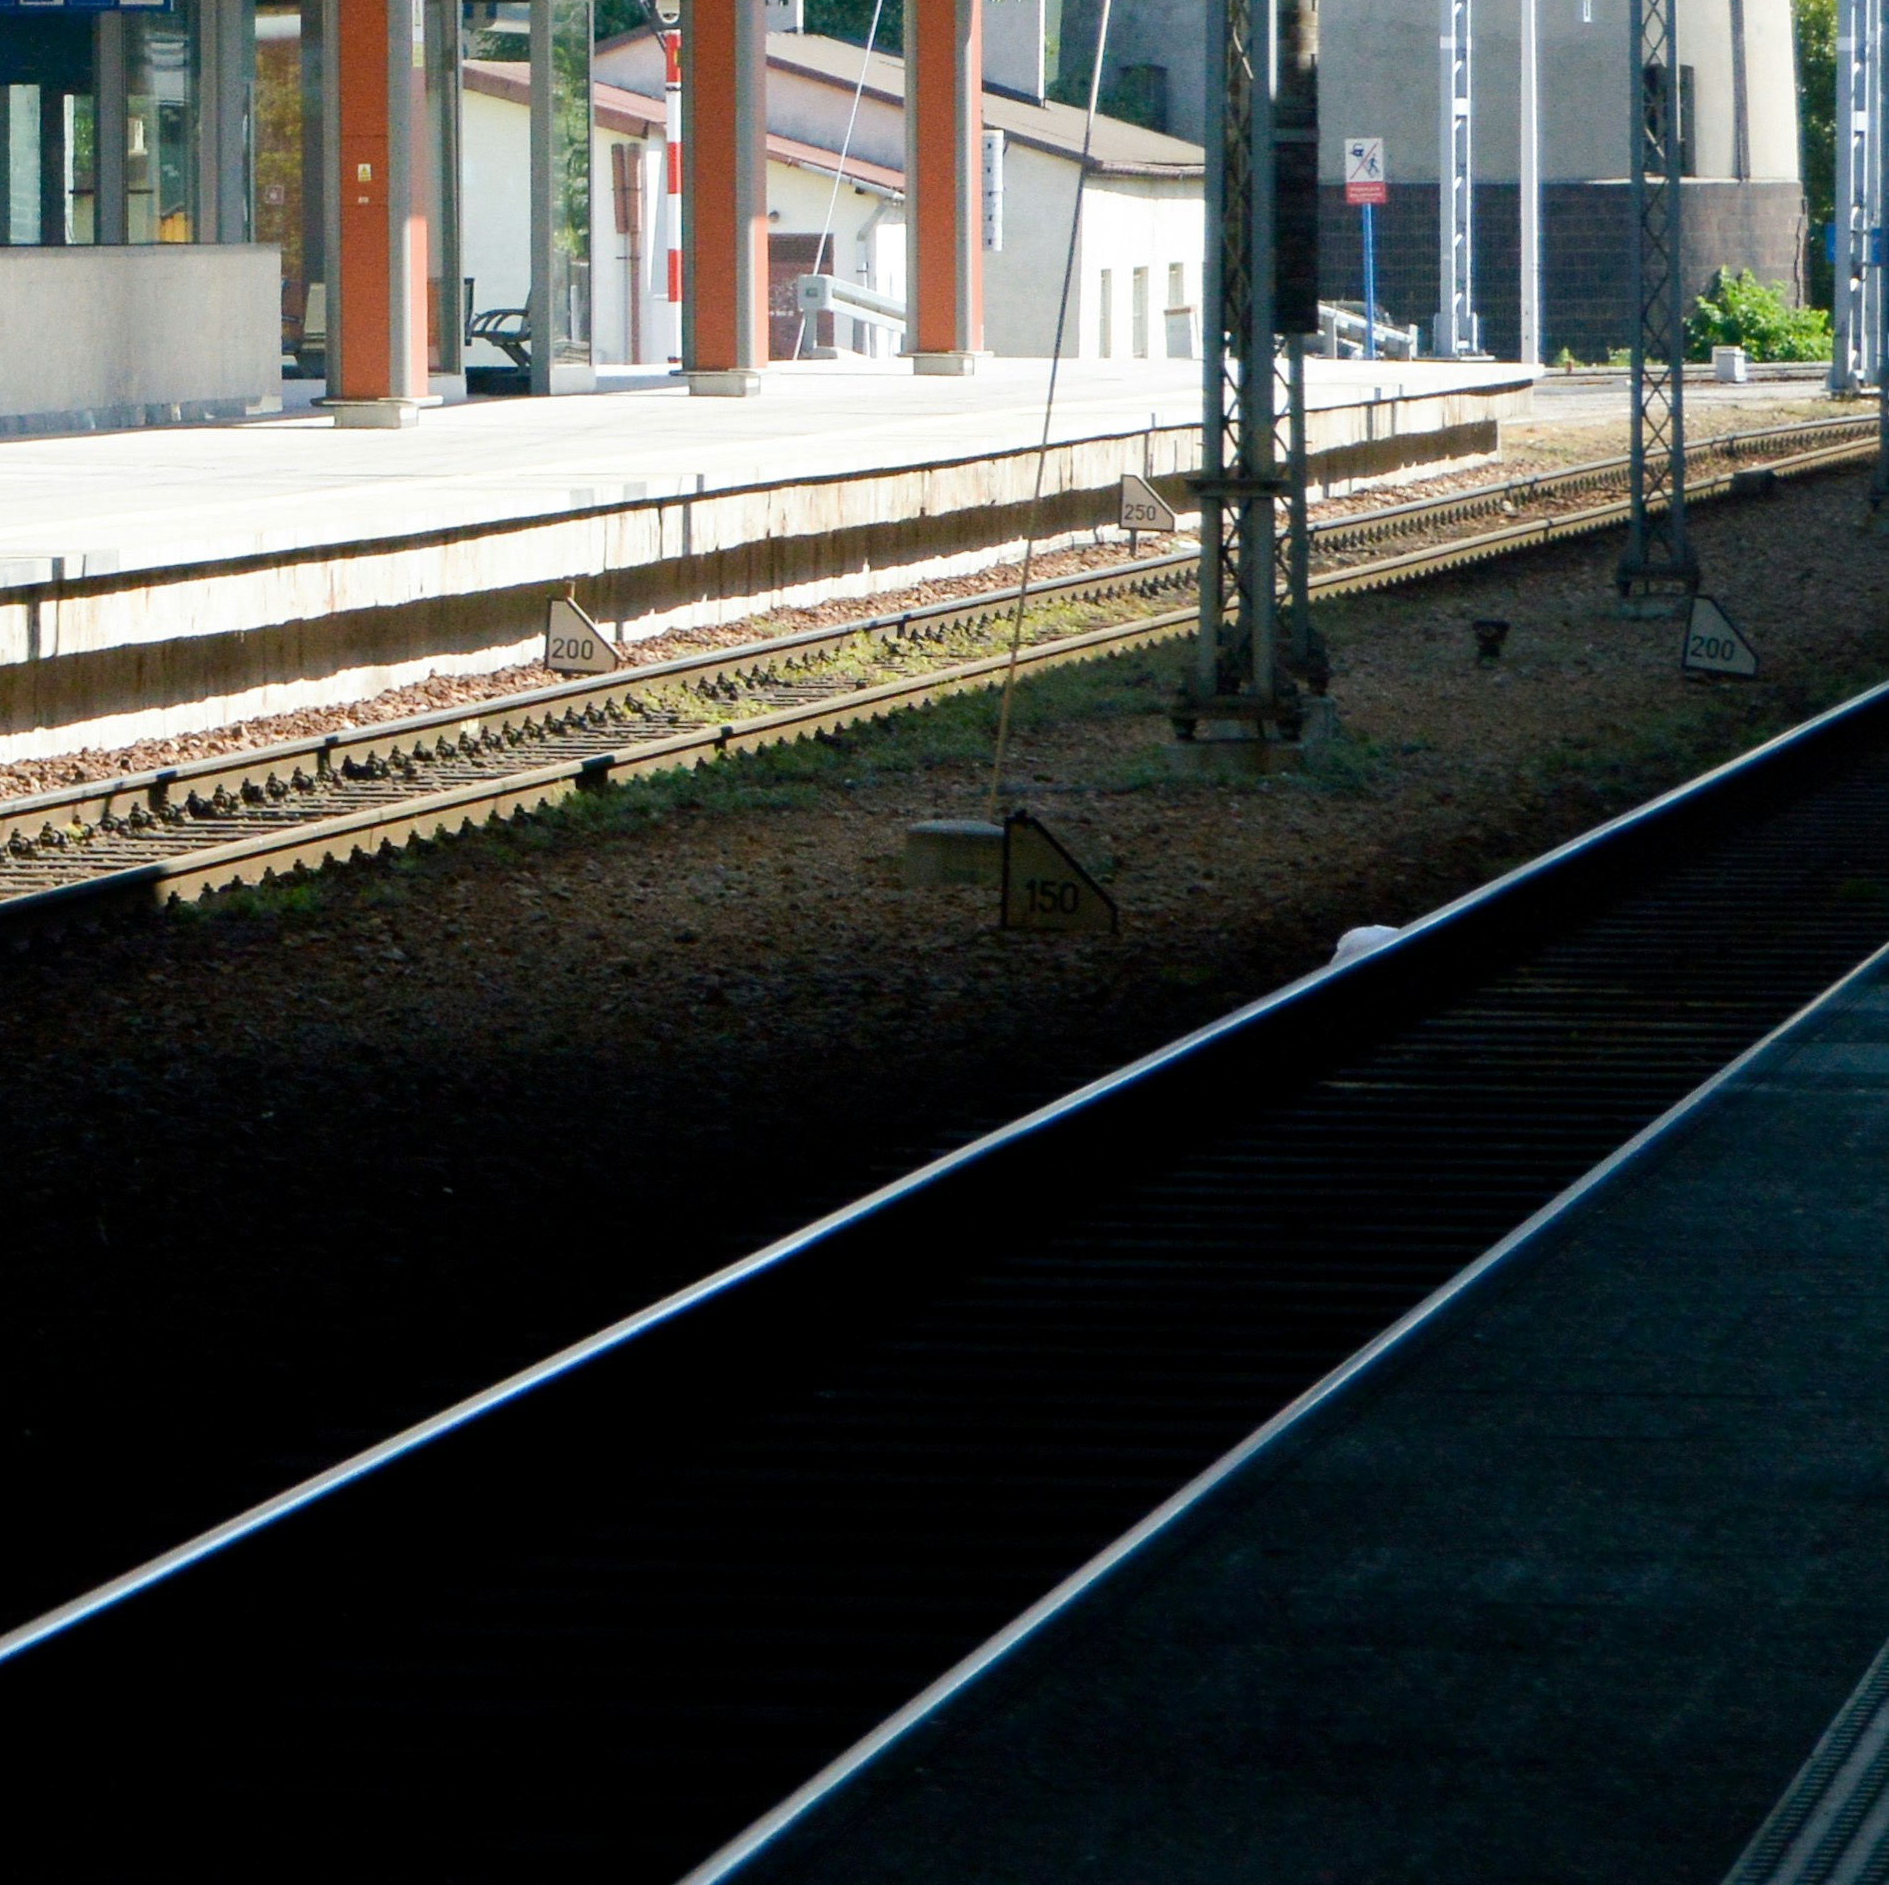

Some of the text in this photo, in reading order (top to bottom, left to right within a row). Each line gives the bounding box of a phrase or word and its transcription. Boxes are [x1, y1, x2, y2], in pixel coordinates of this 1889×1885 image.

[1124, 503, 1157, 521] 250
[551, 637, 594, 661] 200
[1689, 635, 1736, 661] 200
[1024, 877, 1080, 915] 150
